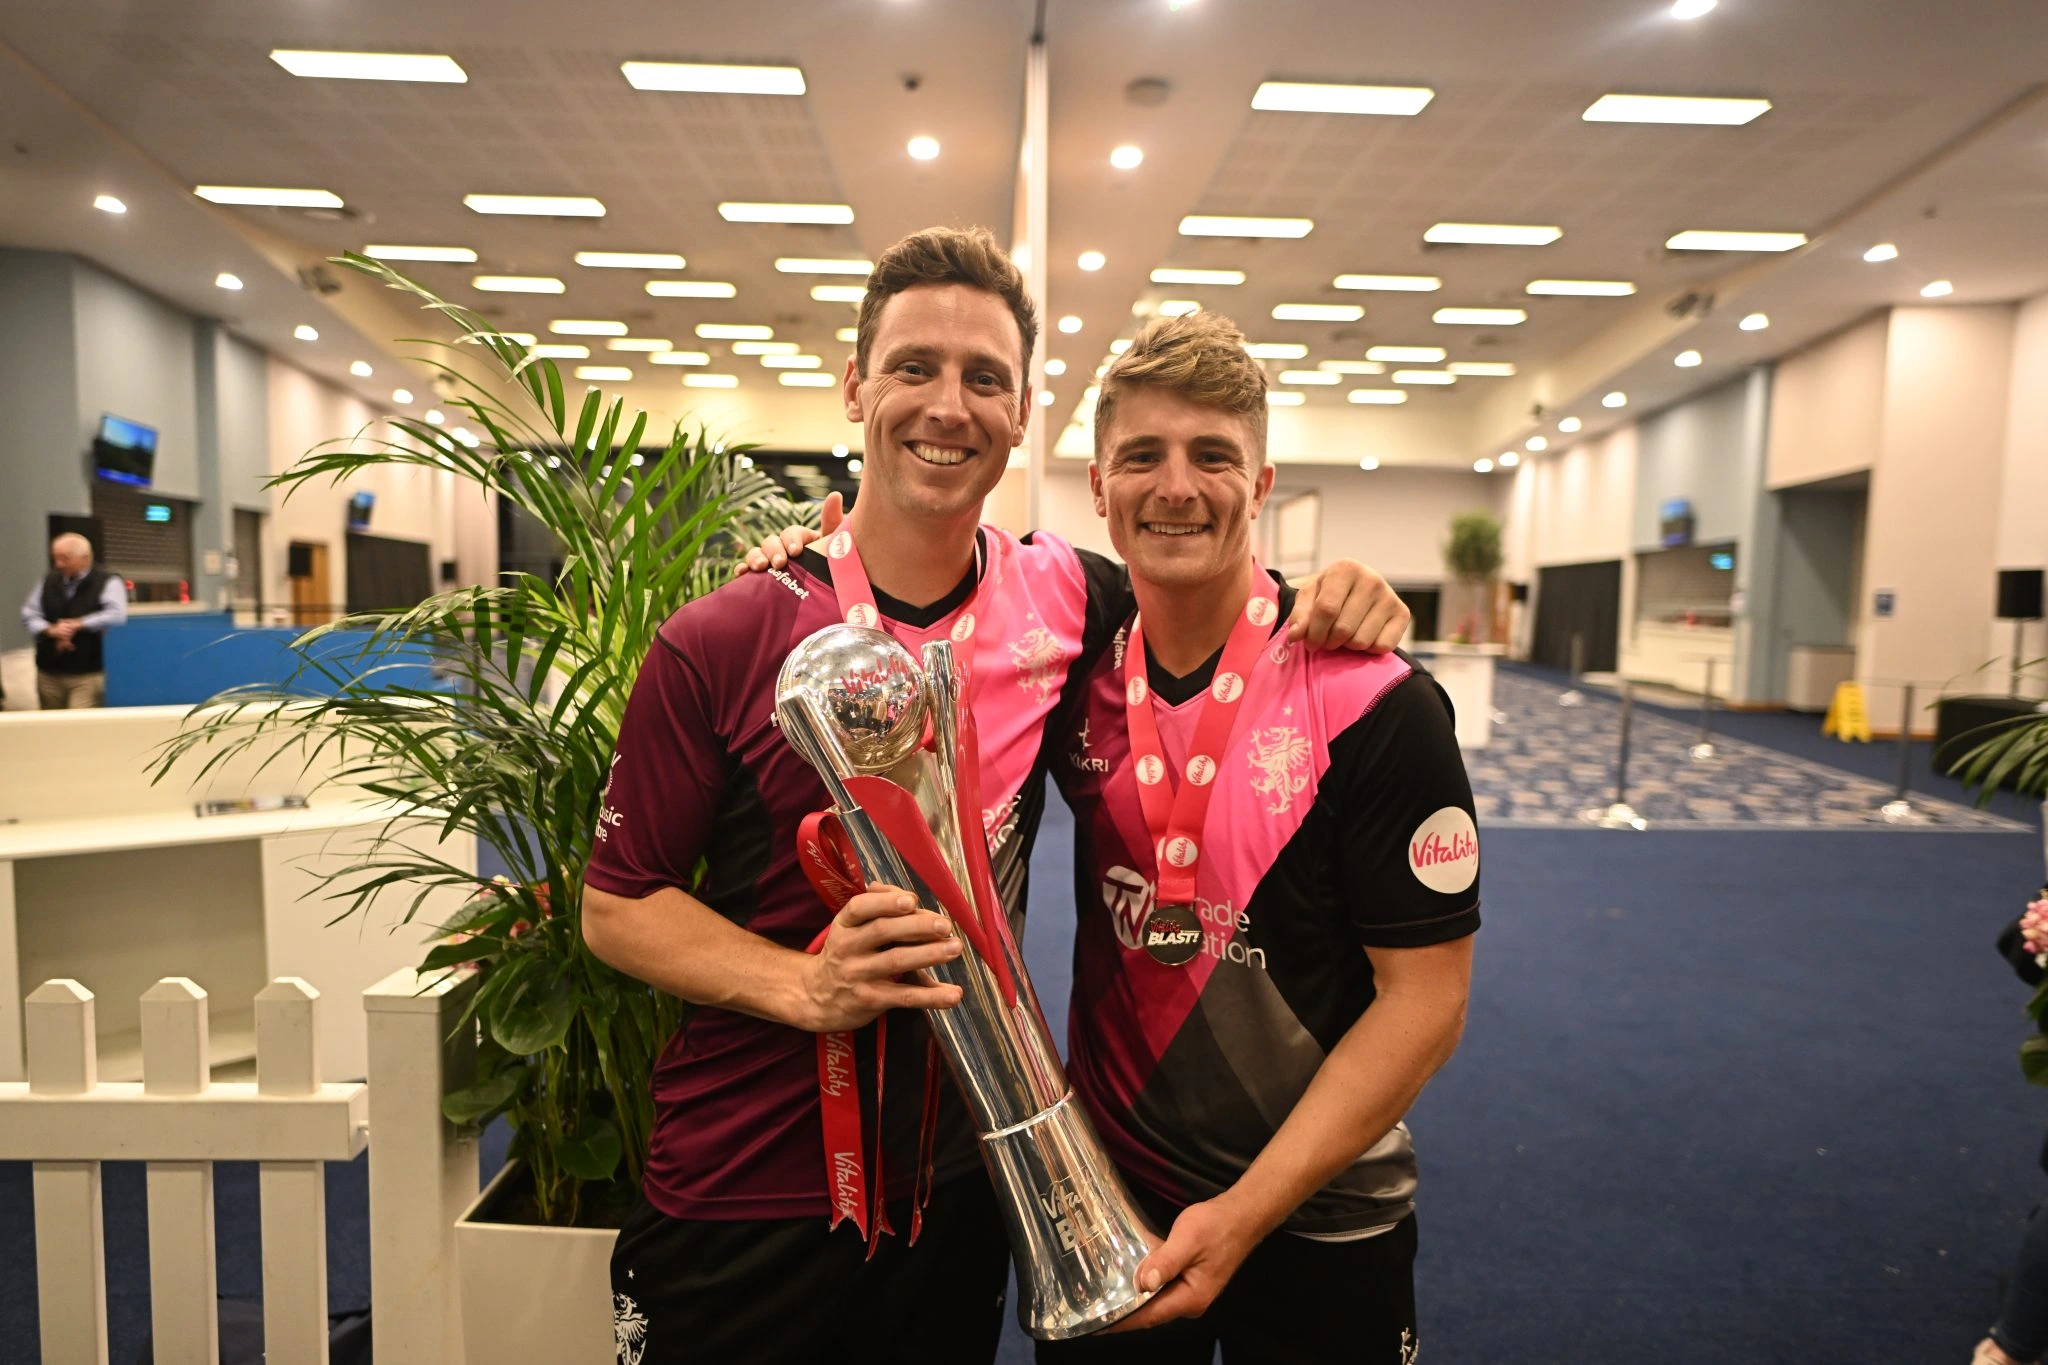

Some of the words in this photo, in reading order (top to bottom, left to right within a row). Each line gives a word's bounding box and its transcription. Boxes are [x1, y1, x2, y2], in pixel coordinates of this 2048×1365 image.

[1412, 830, 1478, 868] Vitality
[1195, 897, 1250, 933] ade
[1147, 931, 1200, 946] BLAST!
[1201, 931, 1267, 970] ation
[820, 1033, 852, 1097] Vitality
[832, 1152, 862, 1213] Vitality
